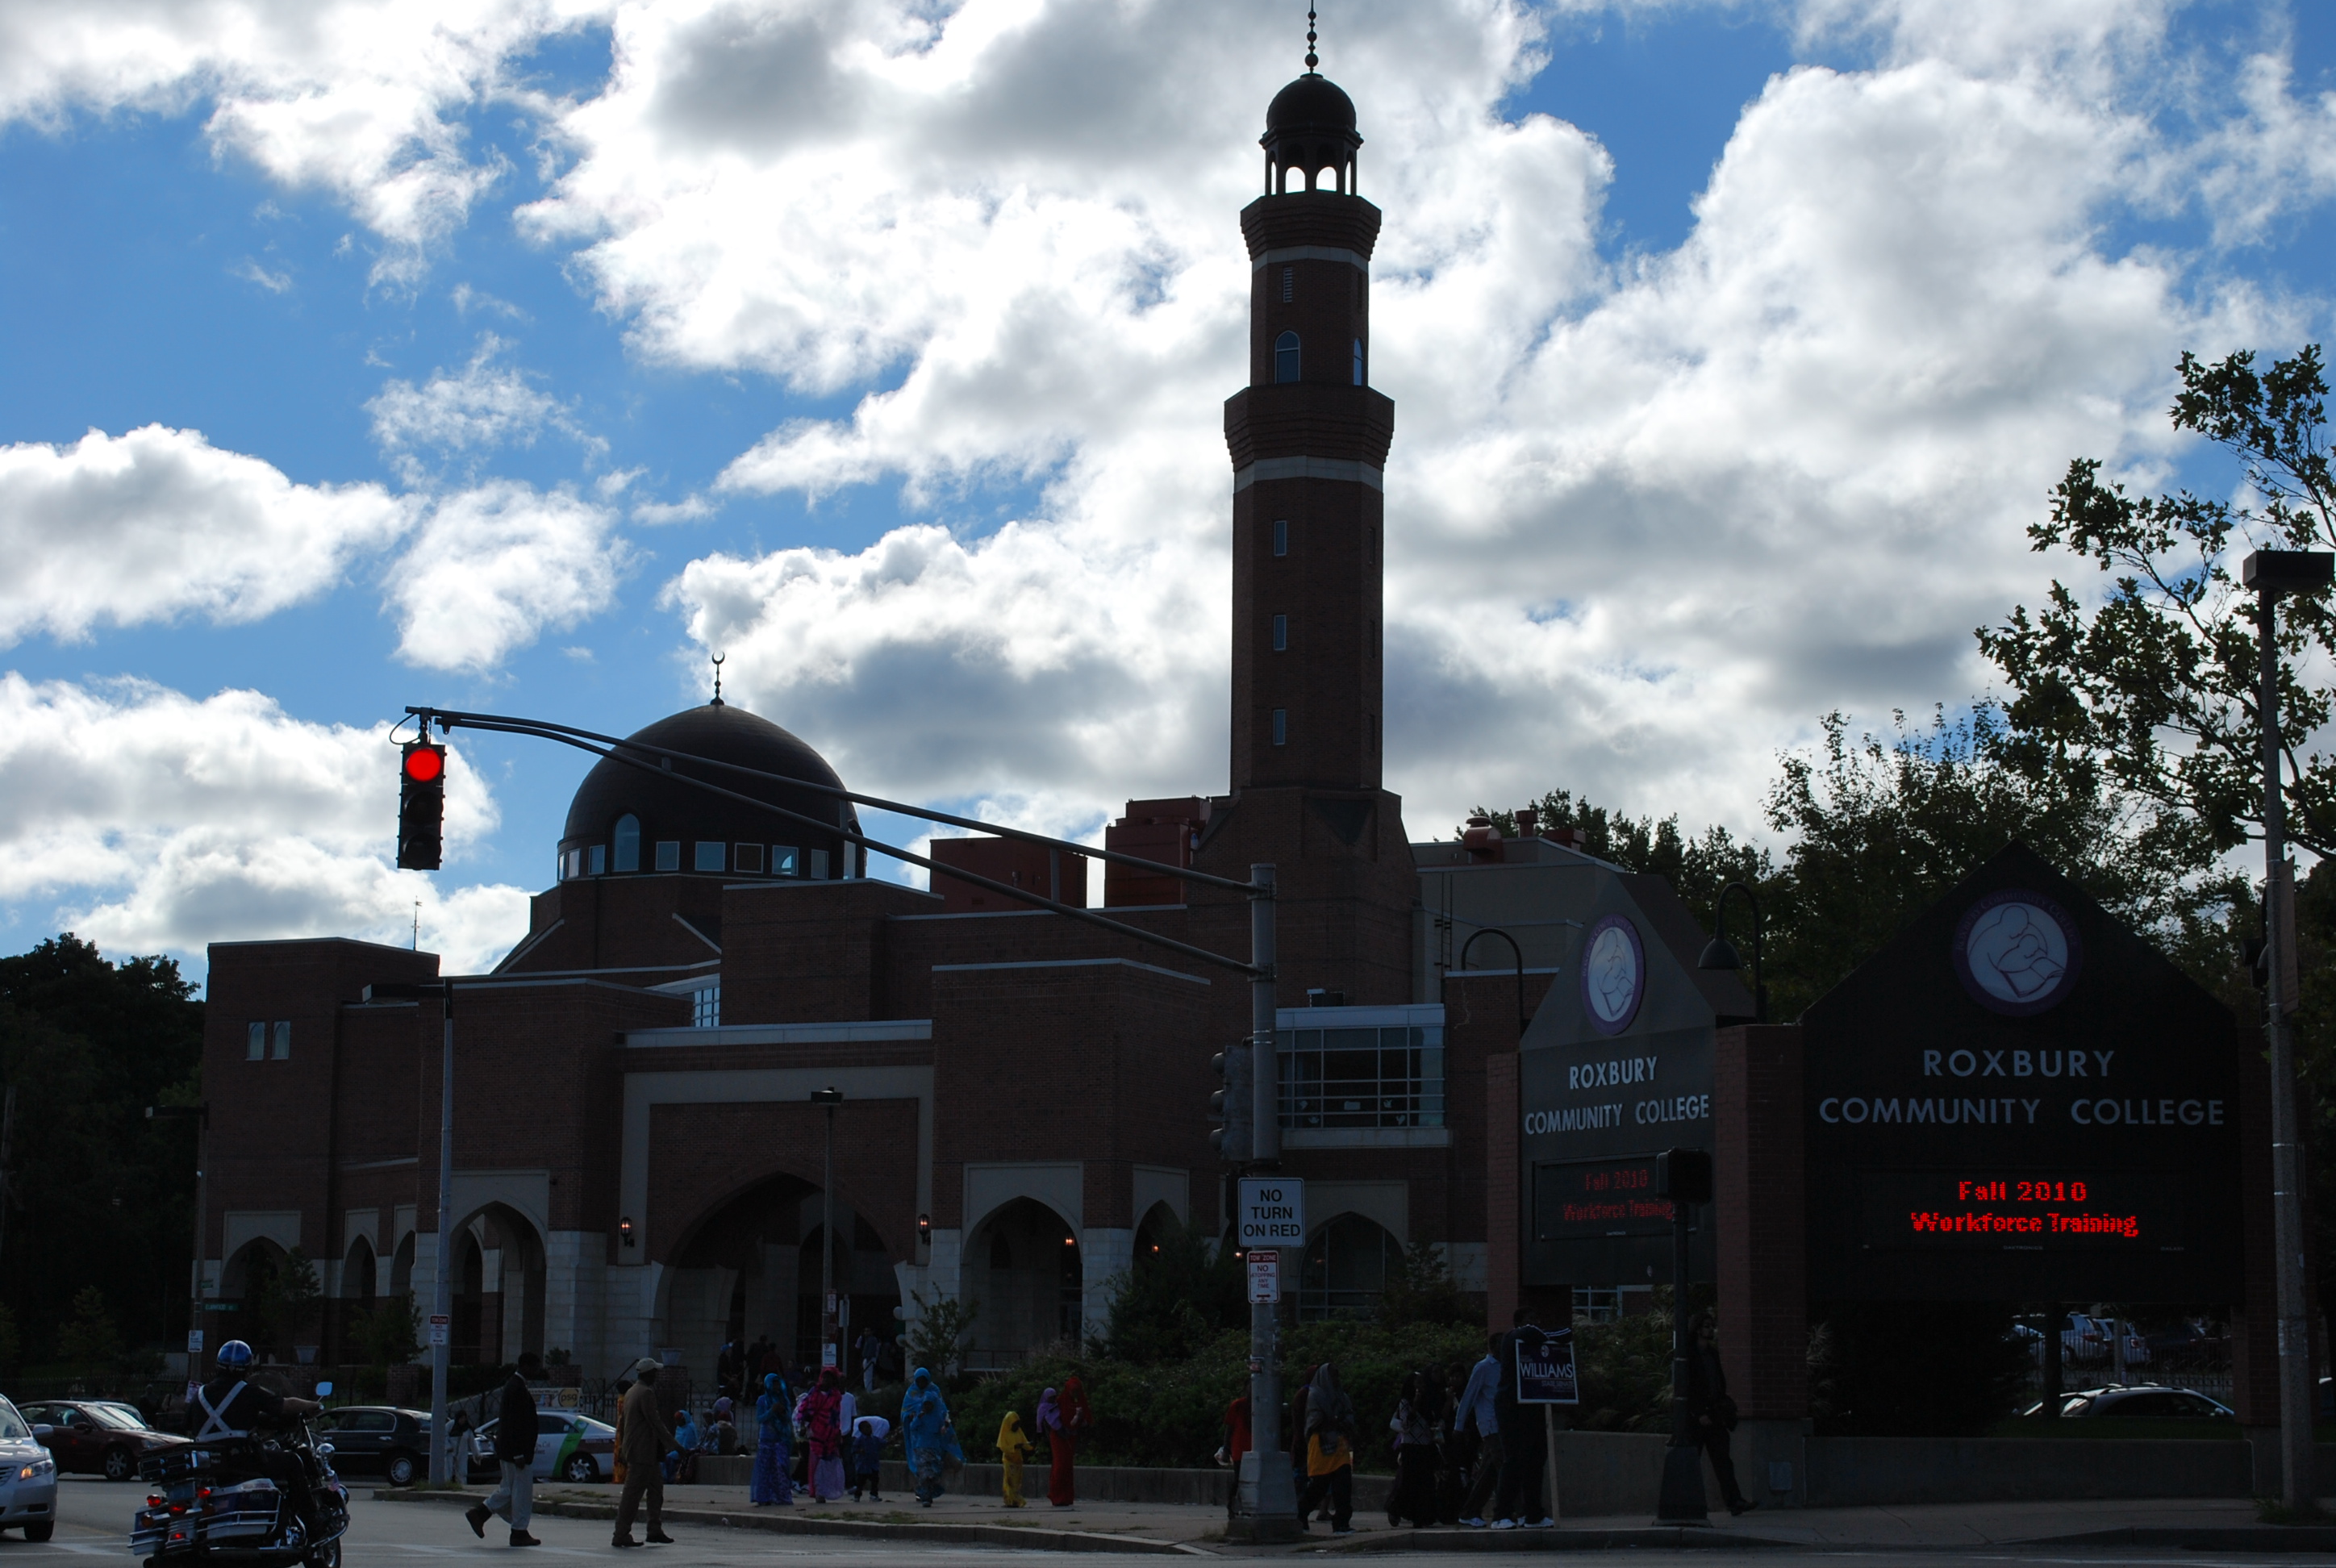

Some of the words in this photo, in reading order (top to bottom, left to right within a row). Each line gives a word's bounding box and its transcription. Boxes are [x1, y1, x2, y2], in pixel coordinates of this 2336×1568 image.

[1569, 1056, 1658, 1090] ROXBURY
[1923, 1049, 2116, 1078] ROXBURY
[1524, 1103, 1624, 1135] COMMUNITY
[1634, 1095, 1710, 1125] COLLEGE
[1818, 1097, 2042, 1125] COMMUNITY
[2070, 1098, 2225, 1126] COLLEGE
[1585, 1171, 1609, 1192] Fall
[1613, 1169, 1649, 1190] 2010
[1958, 1180, 2007, 1201] Fall
[2017, 1180, 2088, 1202] 2010
[1260, 1189, 1283, 1203] NO
[1251, 1207, 1293, 1220] TURN
[1562, 1202, 1626, 1222] Workforce
[1628, 1198, 1675, 1220] Training
[1244, 1224, 1266, 1237] ON
[1270, 1224, 1301, 1236] RED
[1910, 1211, 2043, 1232] Workforce
[2046, 1212, 2140, 1238] Training
[1520, 1362, 1574, 1378] WILLIAMS
[561, 1394, 578, 1404] psg
